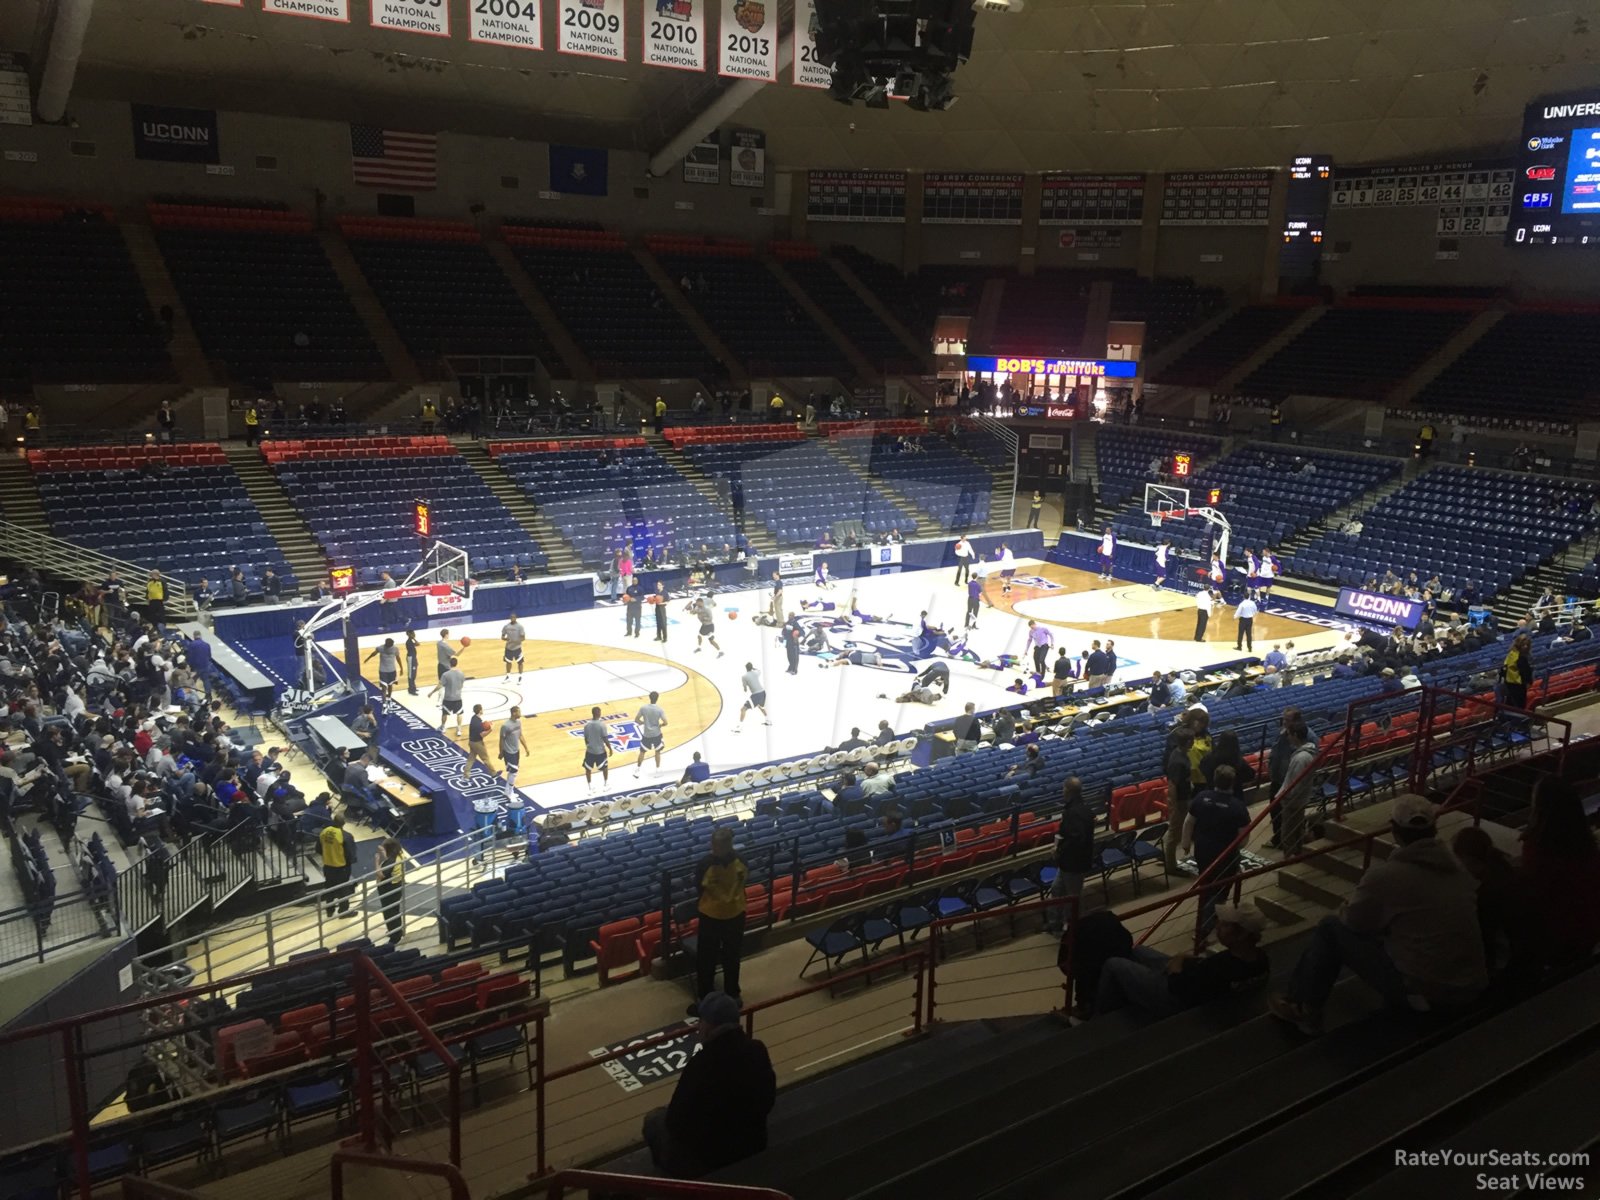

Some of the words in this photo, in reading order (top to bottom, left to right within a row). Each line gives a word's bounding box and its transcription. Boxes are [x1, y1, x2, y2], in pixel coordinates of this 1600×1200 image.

[274, 0, 339, 16] CHAMPIONS
[385, 4, 436, 19] NATIONAL
[475, 0, 536, 21] 2004
[381, 16, 441, 32] CHAMPIONS
[482, 19, 530, 32] NATIONAL
[564, 7, 620, 33] 2009
[478, 30, 534, 45] CHAMPIONS
[570, 31, 614, 44] NATIONAL
[650, 21, 698, 44] 2010
[566, 42, 618, 56] CHAMPIONS
[653, 43, 695, 55] NATIONAL
[727, 34, 770, 56] 2013
[650, 53, 698, 67] CHAMPIONS
[729, 55, 767, 67] NATIONAL
[725, 65, 770, 78] CHAMPIONS
[143, 122, 209, 141] UCONN
[1376, 190, 1392, 201] 22
[1398, 189, 1415, 200] 25
[1421, 188, 1438, 199] 42
[1444, 186, 1461, 198] 44
[1493, 184, 1511, 196] 42
[1443, 219, 1455, 231] 13
[1464, 218, 1481, 230] 22
[1515, 229, 1526, 242] 0
[997, 358, 1046, 373] BOB'S
[1046, 363, 1105, 375] FURNITURE
[1176, 463, 1188, 474] 30
[336, 578, 349, 588] 30
[1348, 592, 1412, 618] UCONN
[1354, 609, 1397, 623] BASKETBALL
